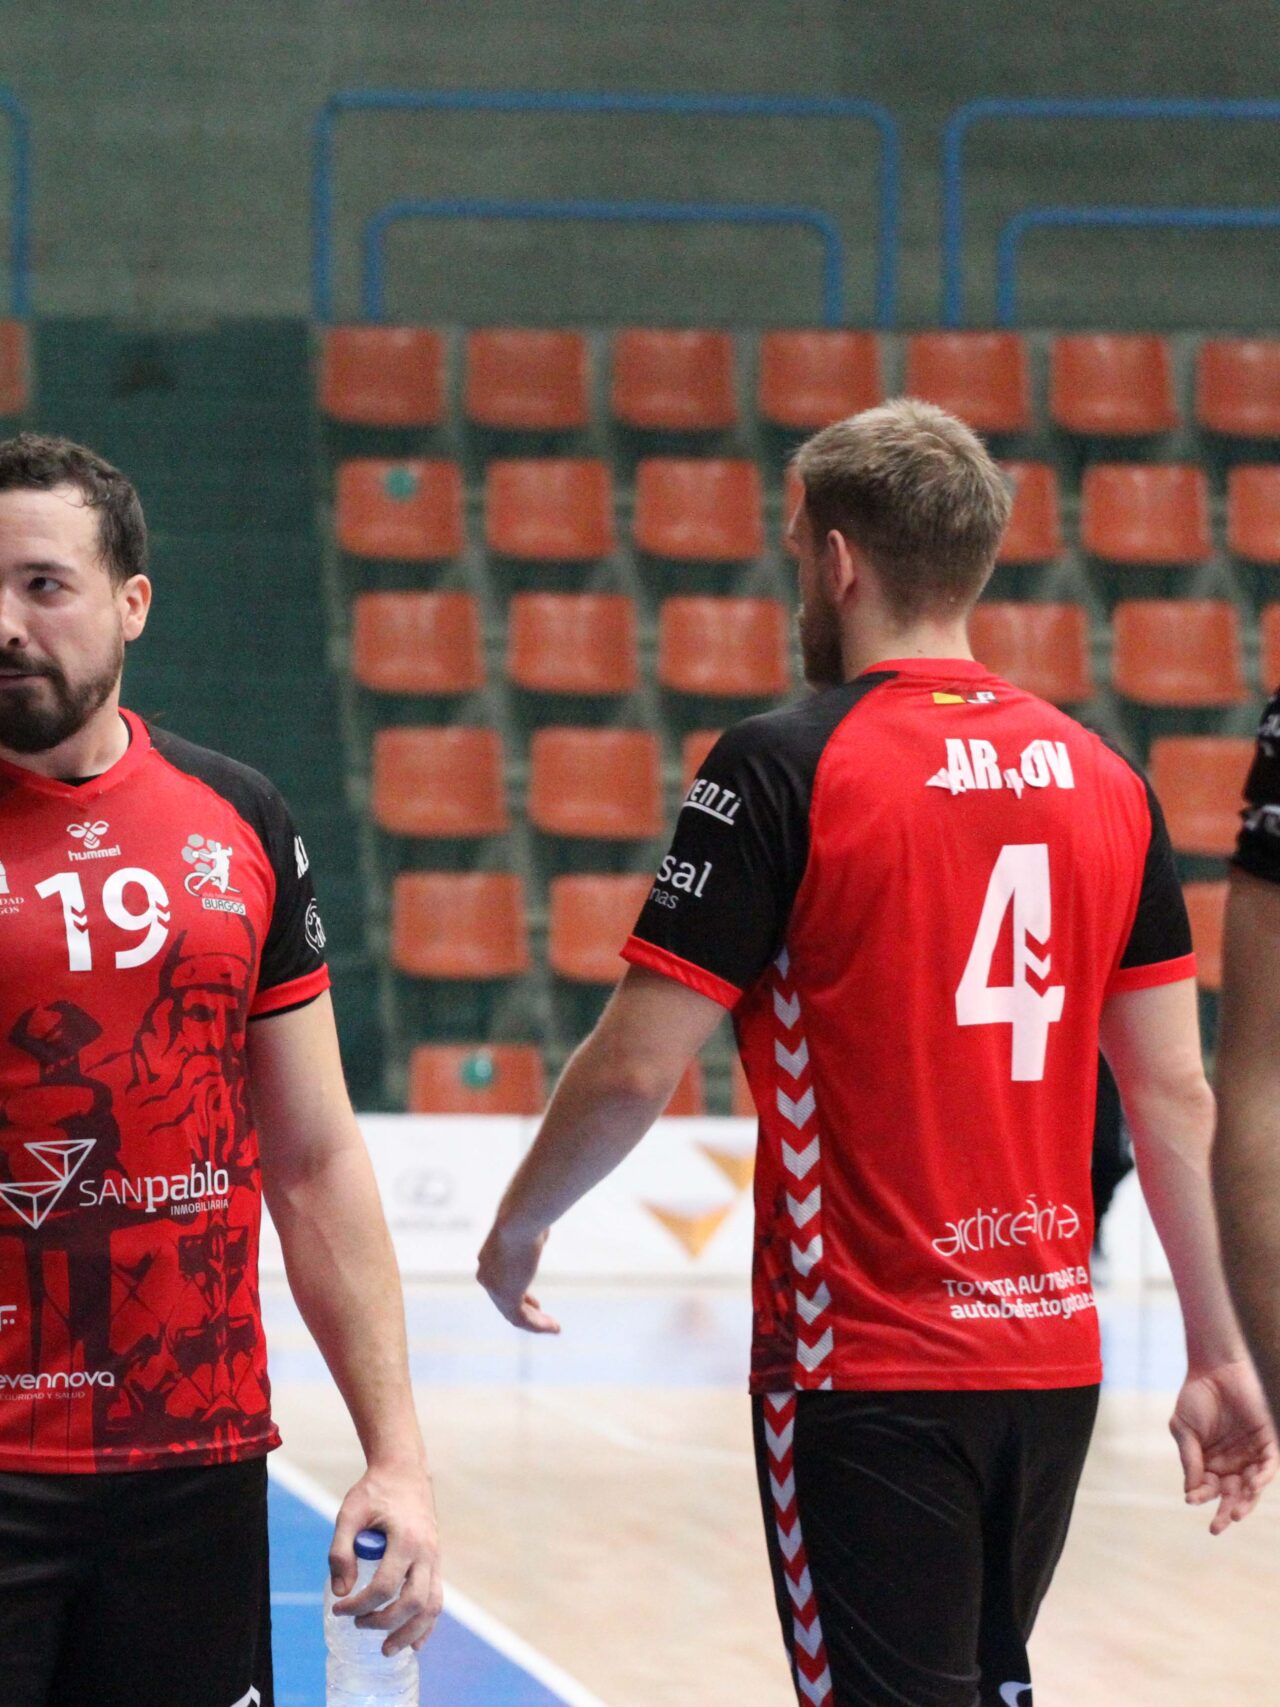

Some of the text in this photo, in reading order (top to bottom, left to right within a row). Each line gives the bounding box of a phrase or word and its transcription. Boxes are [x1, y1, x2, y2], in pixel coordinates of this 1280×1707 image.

[67, 844, 122, 861] hummel
[204, 898, 245, 914] BURGOS
[34, 866, 171, 972] 19
[954, 843, 1065, 1082] 4
[170, 1198, 229, 1216] INMOBILIARIA
[55, 1391, 86, 1399] SALUD
